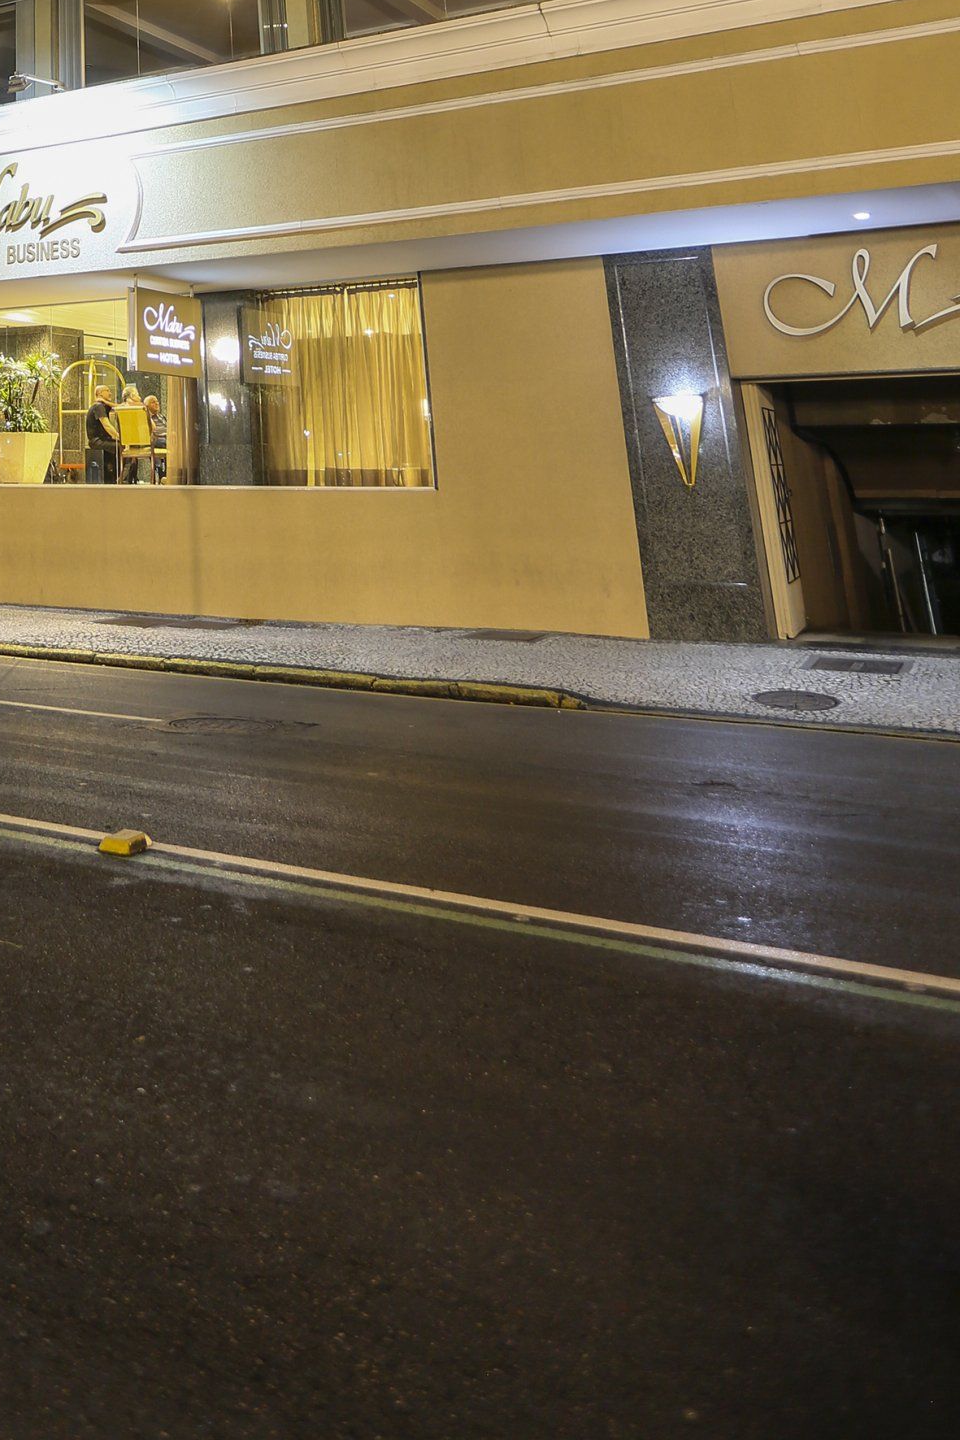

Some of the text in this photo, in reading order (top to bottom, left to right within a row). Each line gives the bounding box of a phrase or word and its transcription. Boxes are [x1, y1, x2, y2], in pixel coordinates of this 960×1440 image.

[6, 237, 81, 265] BUSINESS
[143, 302, 183, 333] Mabu
[159, 352, 181, 365] HOTEL
